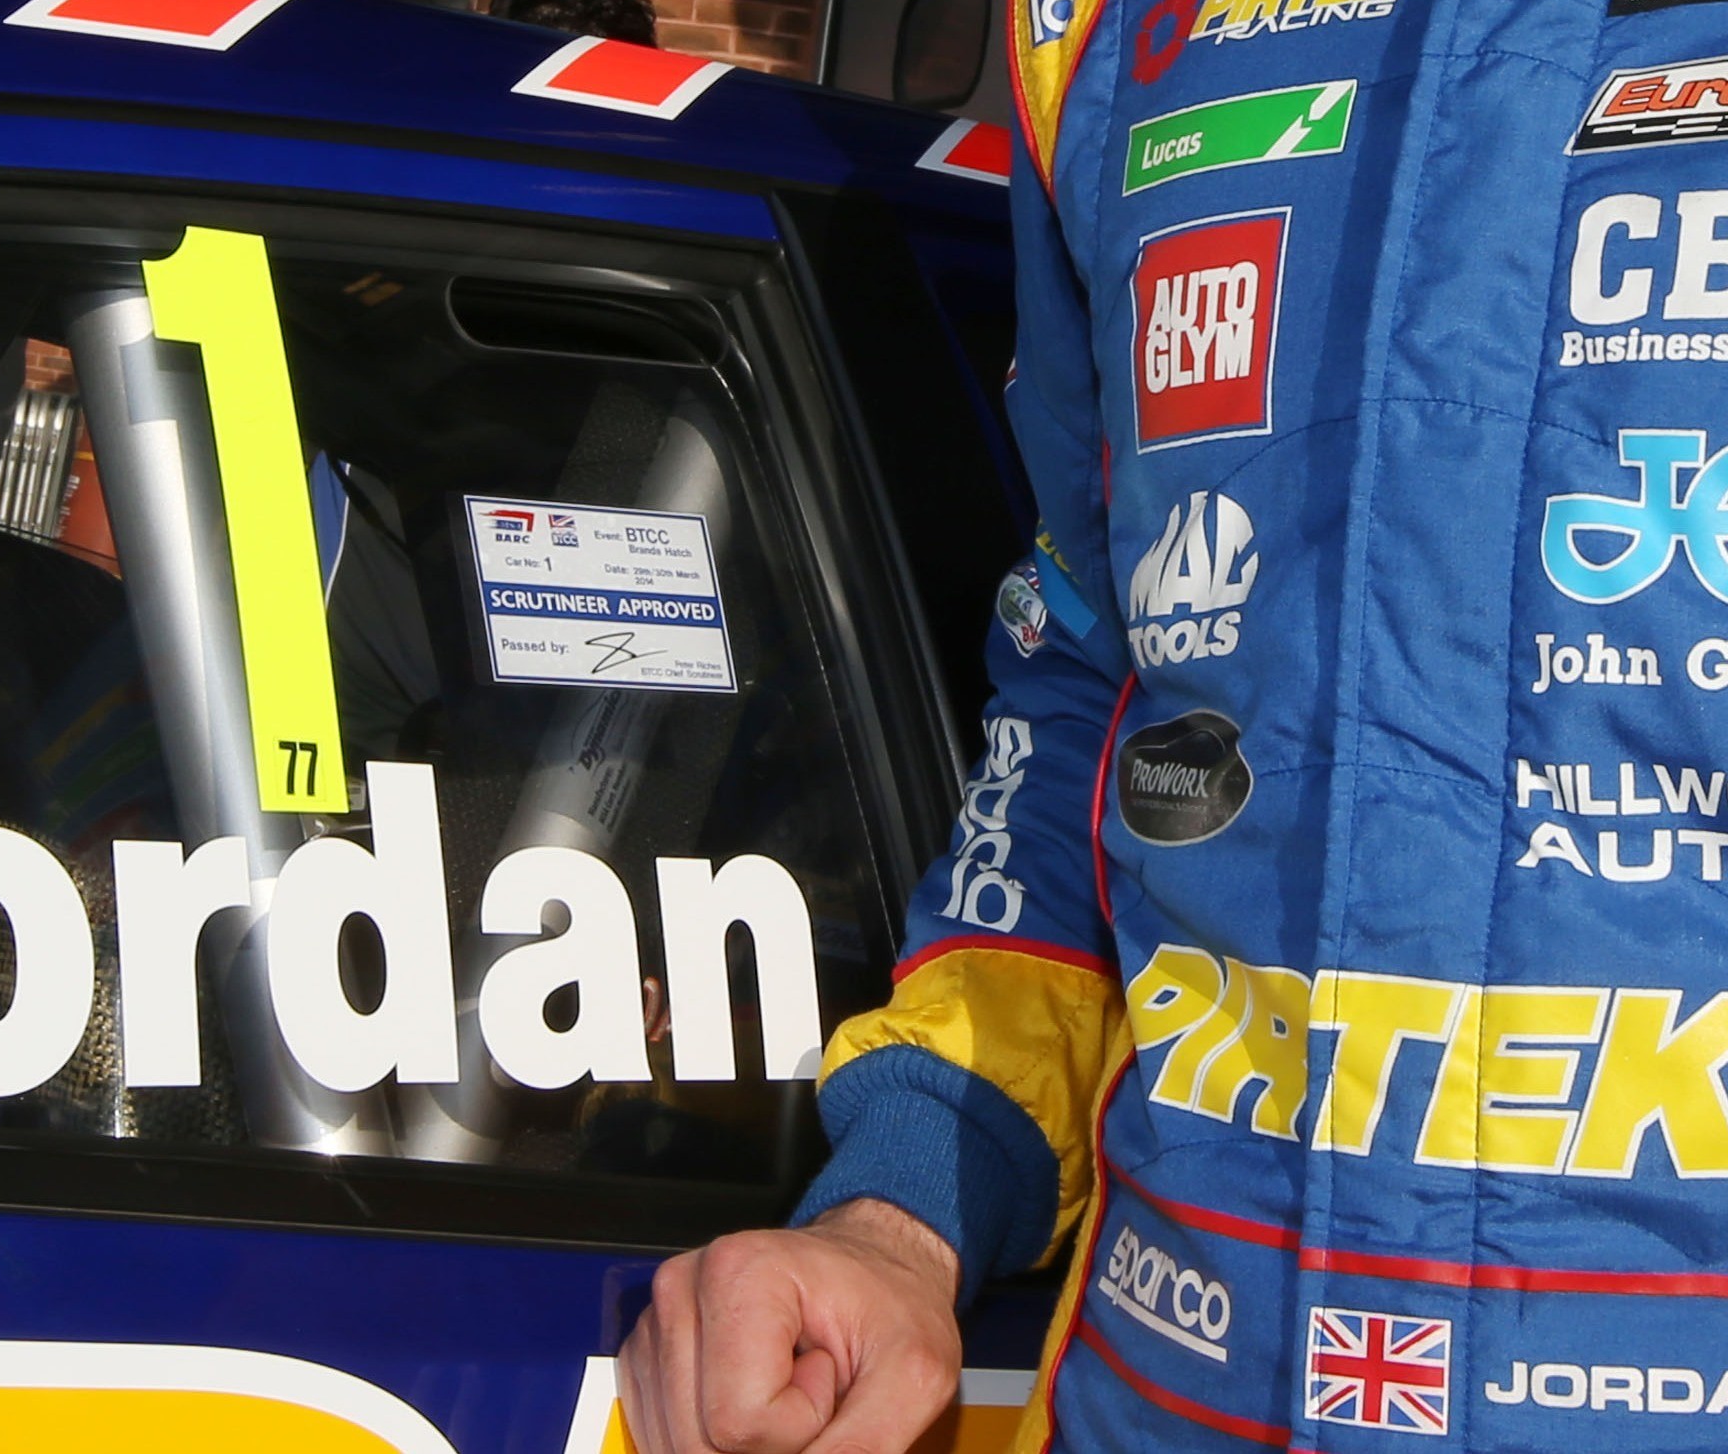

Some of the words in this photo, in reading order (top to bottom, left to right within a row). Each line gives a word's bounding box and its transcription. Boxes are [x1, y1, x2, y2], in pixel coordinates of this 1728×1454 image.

[1141, 131, 1204, 171] Lucas
[1147, 261, 1259, 338] AUTO
[1145, 319, 1255, 394] GLYM
[142, 225, 349, 814] 1
[495, 533, 530, 544] BARC
[625, 527, 670, 545] BTCC
[505, 556, 522, 567] Car
[544, 556, 553, 573] 1
[604, 563, 630, 575] Date:
[665, 547, 692, 558] Hatch
[1129, 490, 1259, 621] MAC
[490, 589, 612, 616] SCRUTINEER
[618, 598, 715, 622] APPROVED
[501, 638, 547, 653] Passed
[551, 640, 570, 655] by:
[1129, 610, 1242, 670] TOOLS
[1532, 633, 1662, 695] John
[279, 740, 318, 796] 77
[1108, 1225, 1231, 1342] sparco
